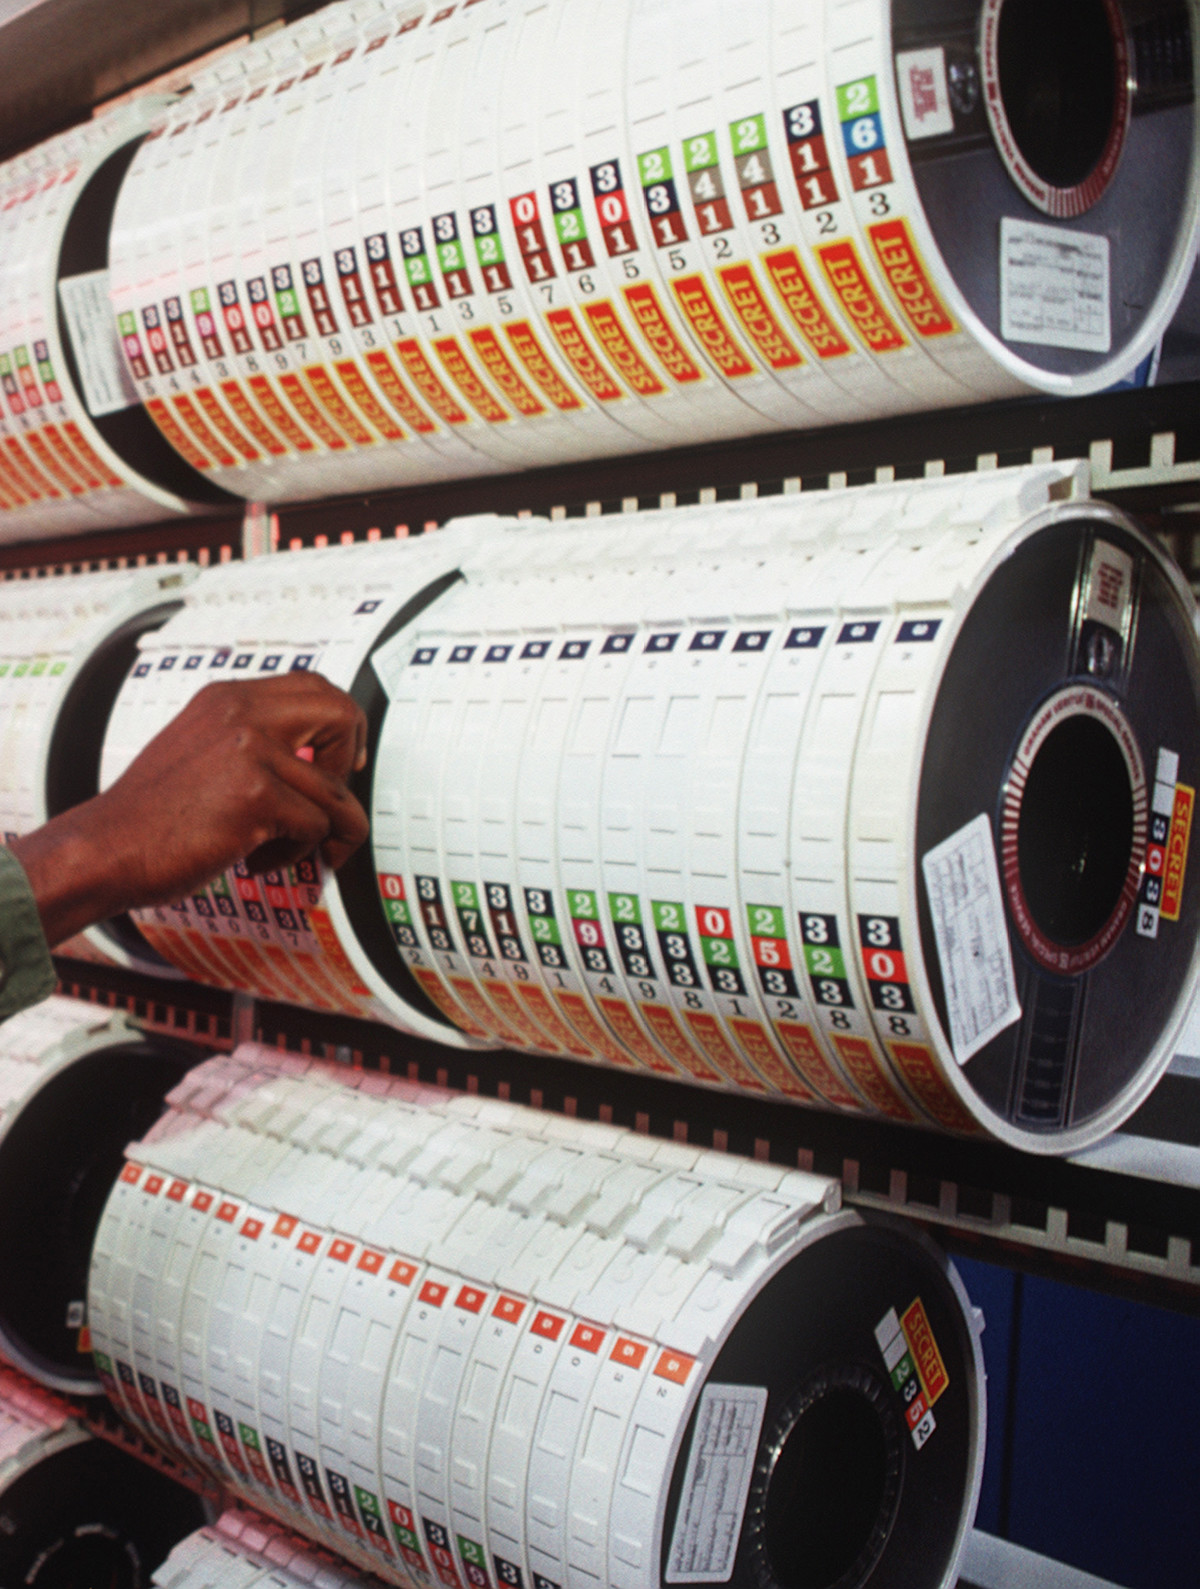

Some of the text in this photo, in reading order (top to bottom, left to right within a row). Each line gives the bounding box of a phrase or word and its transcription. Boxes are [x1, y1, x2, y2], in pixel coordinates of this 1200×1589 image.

[726, 278, 791, 362] SECRET
[773, 264, 838, 350] SECRET
[825, 257, 893, 345] SECRET
[876, 235, 943, 333] SECRET
[511, 332, 572, 405] SECRET
[553, 319, 614, 399] SECRET
[593, 313, 654, 389] SECRET
[630, 296, 692, 375] SECRET
[679, 289, 743, 373] SECRET
[442, 351, 501, 418] SECRET
[477, 339, 536, 411] SECRET
[1165, 801, 1190, 900] SECRET
[909, 1312, 943, 1386] SECRET
